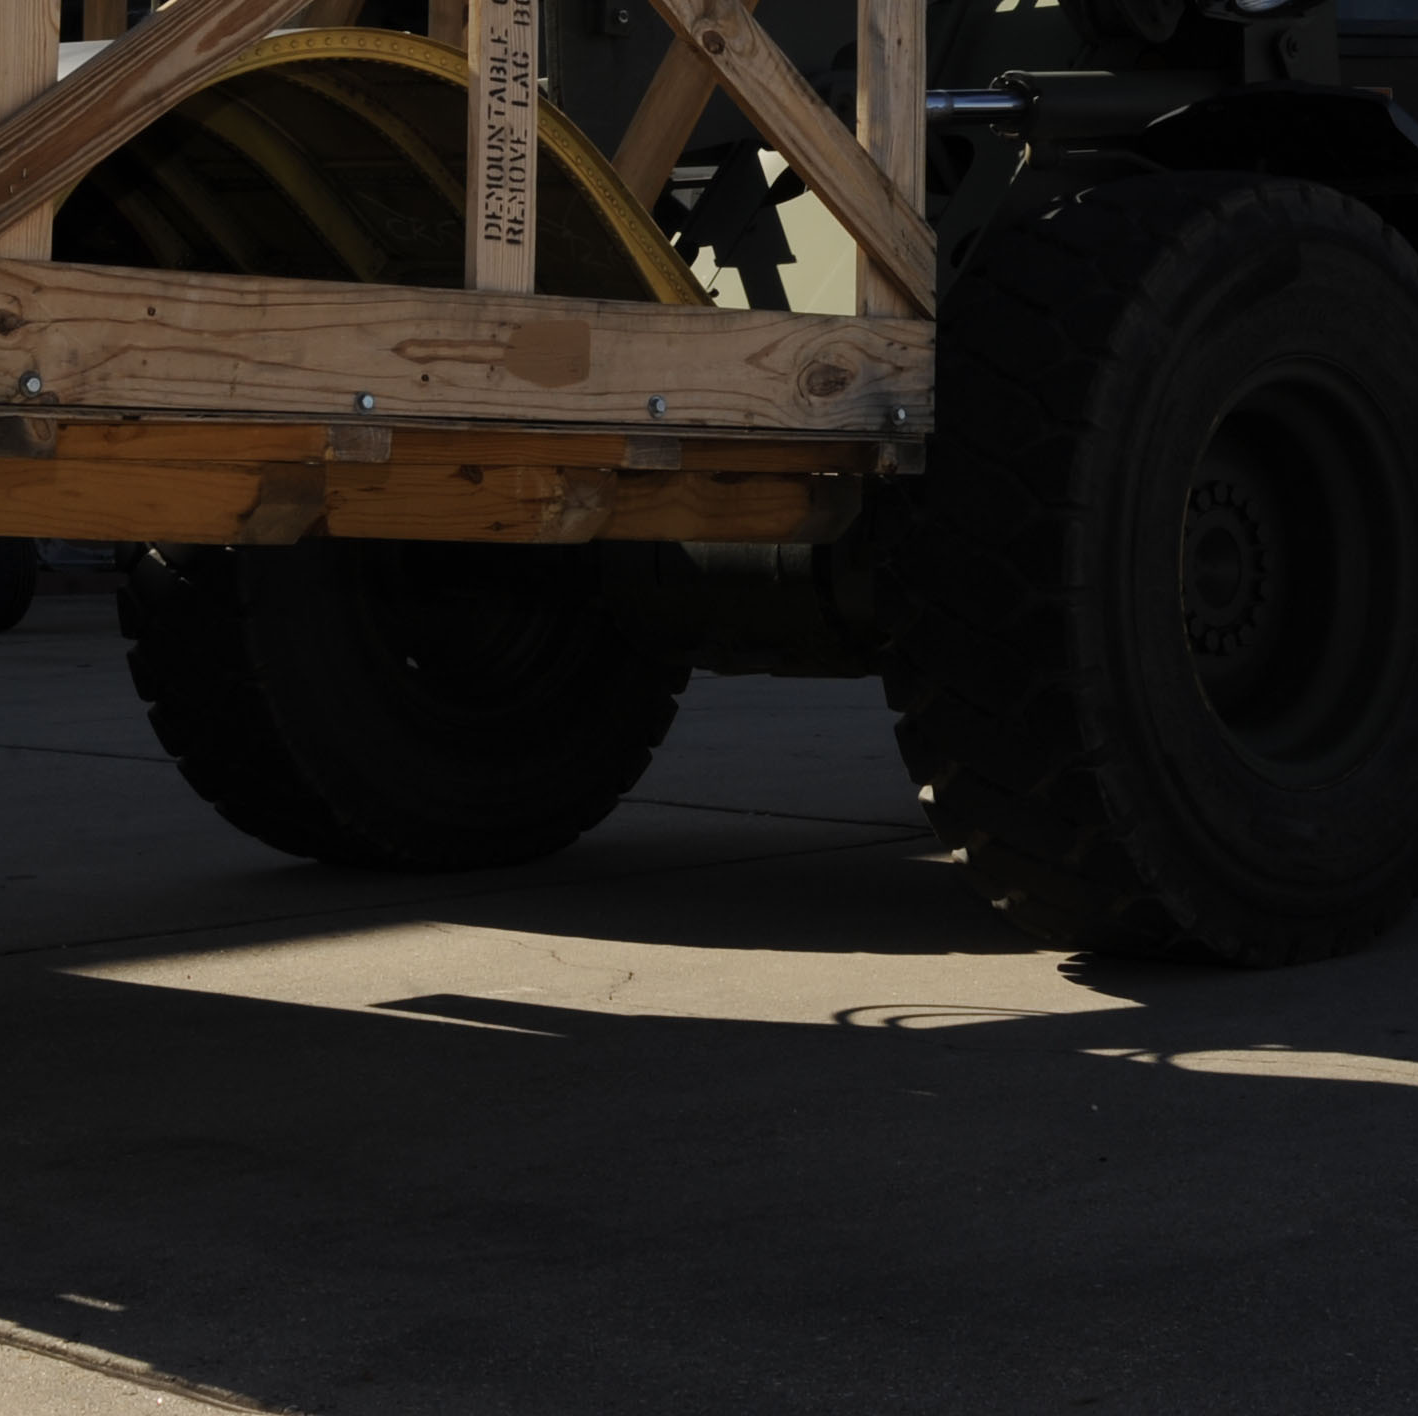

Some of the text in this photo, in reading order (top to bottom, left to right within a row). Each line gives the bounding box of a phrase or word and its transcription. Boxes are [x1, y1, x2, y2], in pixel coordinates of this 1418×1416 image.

[484, 27, 509, 242] DEMOUNTABLE
[510, 51, 530, 108] LAG
[505, 128, 529, 246] REMOVE
